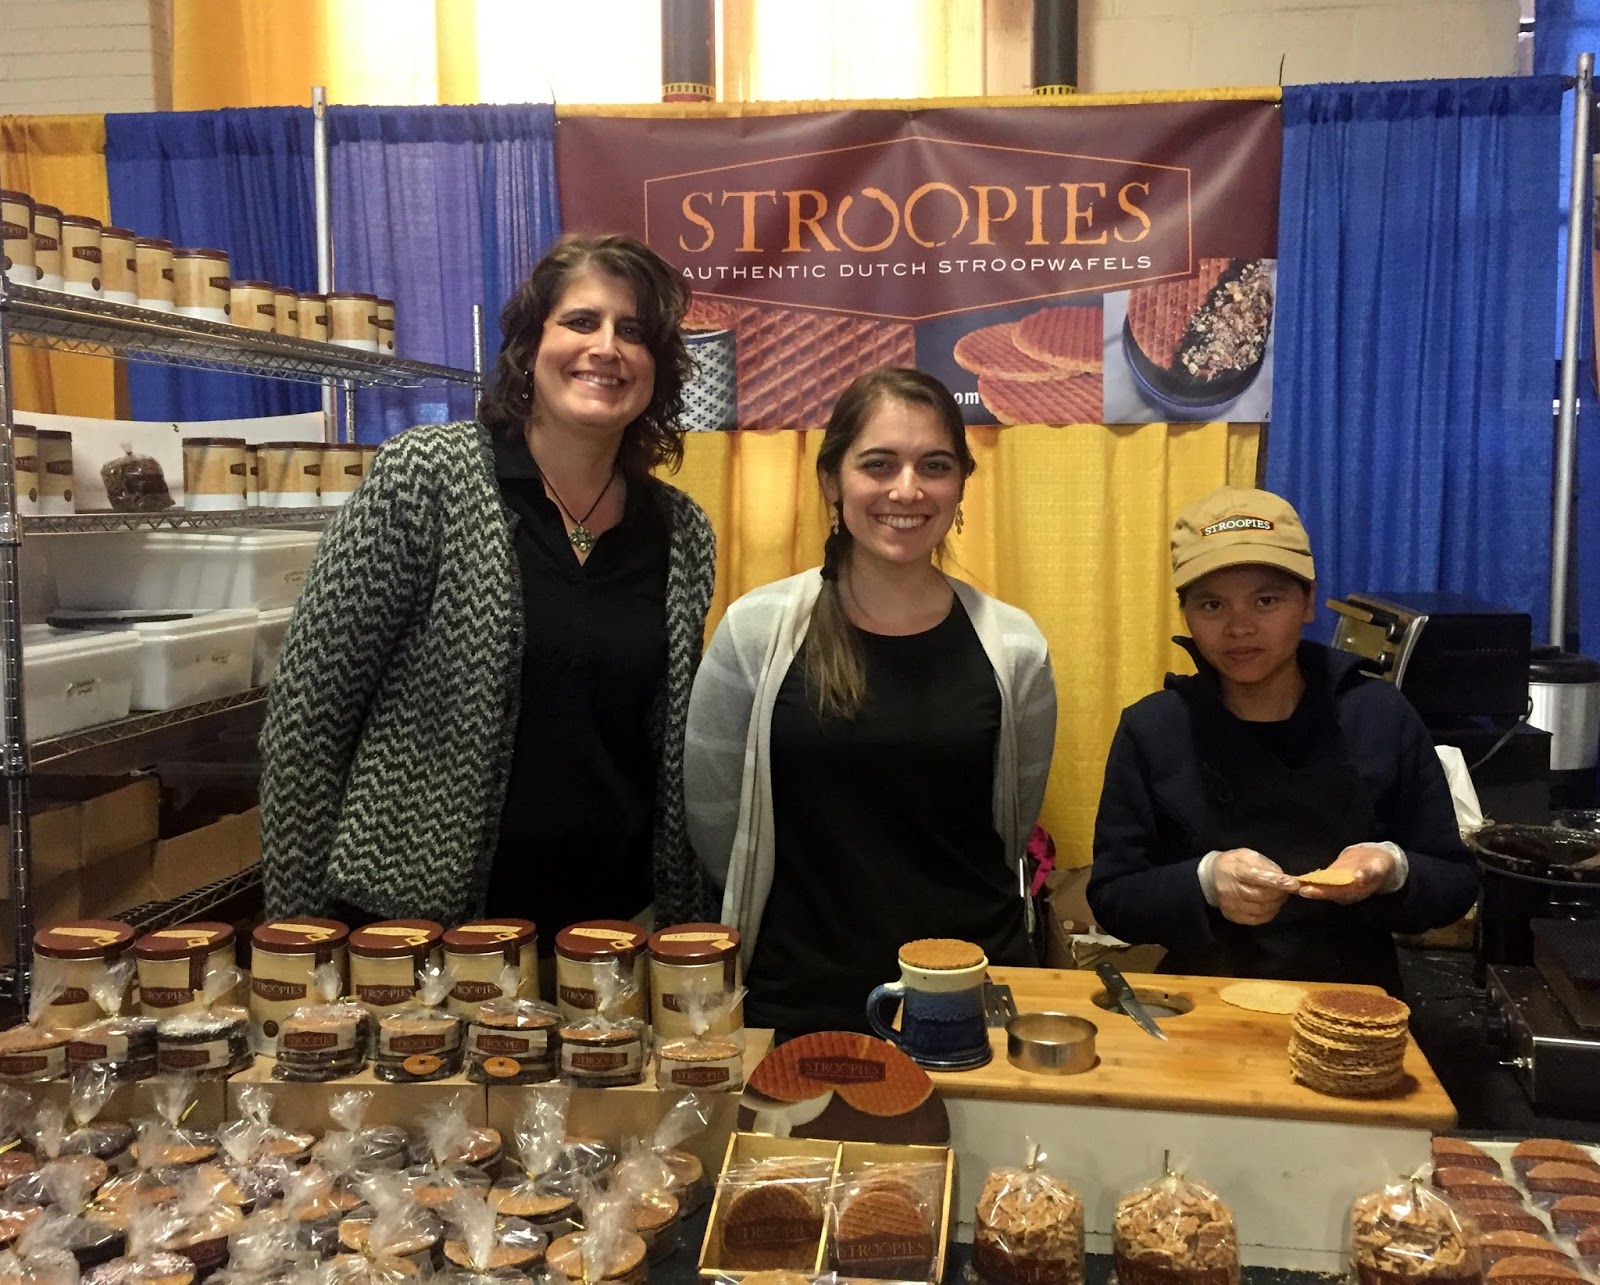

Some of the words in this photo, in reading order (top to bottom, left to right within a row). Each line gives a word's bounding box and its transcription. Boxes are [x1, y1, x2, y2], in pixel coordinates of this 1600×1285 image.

[679, 181, 1151, 253] STROOPIES
[682, 265, 826, 279] AUTHENTIC
[840, 262, 926, 277] DUTCH
[938, 255, 1152, 274] STROOPWAFELS
[1204, 518, 1271, 535] STROOPIES
[144, 990, 190, 1001] TROOPIES
[804, 1060, 880, 1075] STROOPIES
[839, 1241, 925, 1259] STROOPIES
